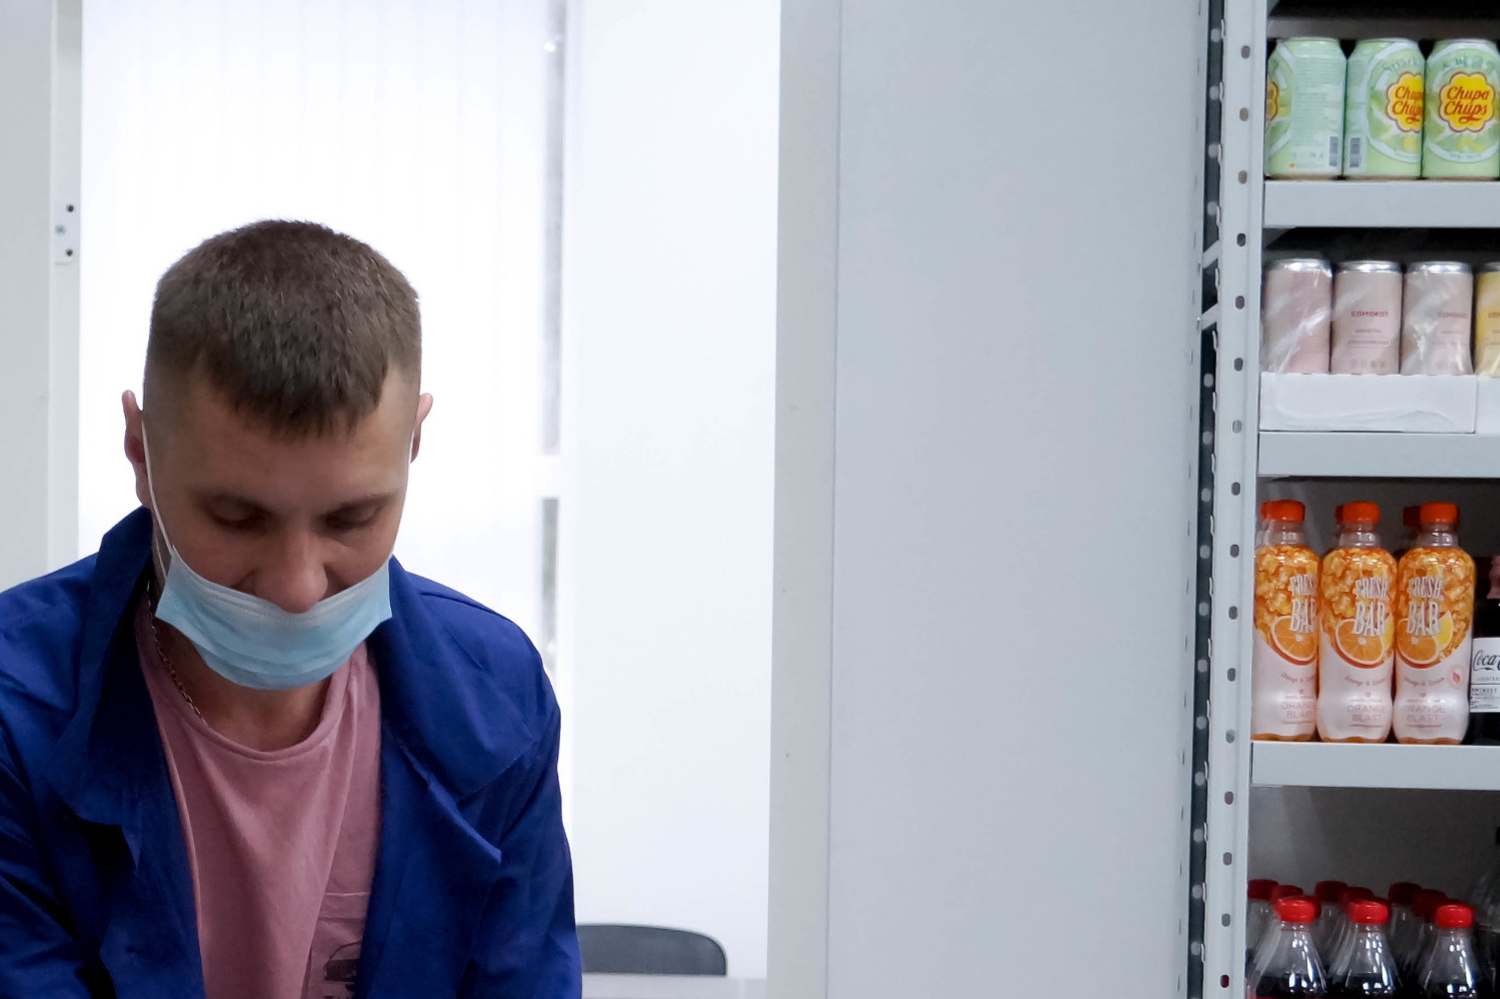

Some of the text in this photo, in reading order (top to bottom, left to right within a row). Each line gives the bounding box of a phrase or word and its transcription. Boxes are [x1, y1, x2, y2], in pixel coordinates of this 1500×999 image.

[1447, 87, 1490, 101] Chupa
[1355, 577, 1389, 599] FRESH
[1409, 576, 1443, 600] FRESH
[1352, 600, 1387, 637] BAR
[1407, 600, 1441, 635] BAR
